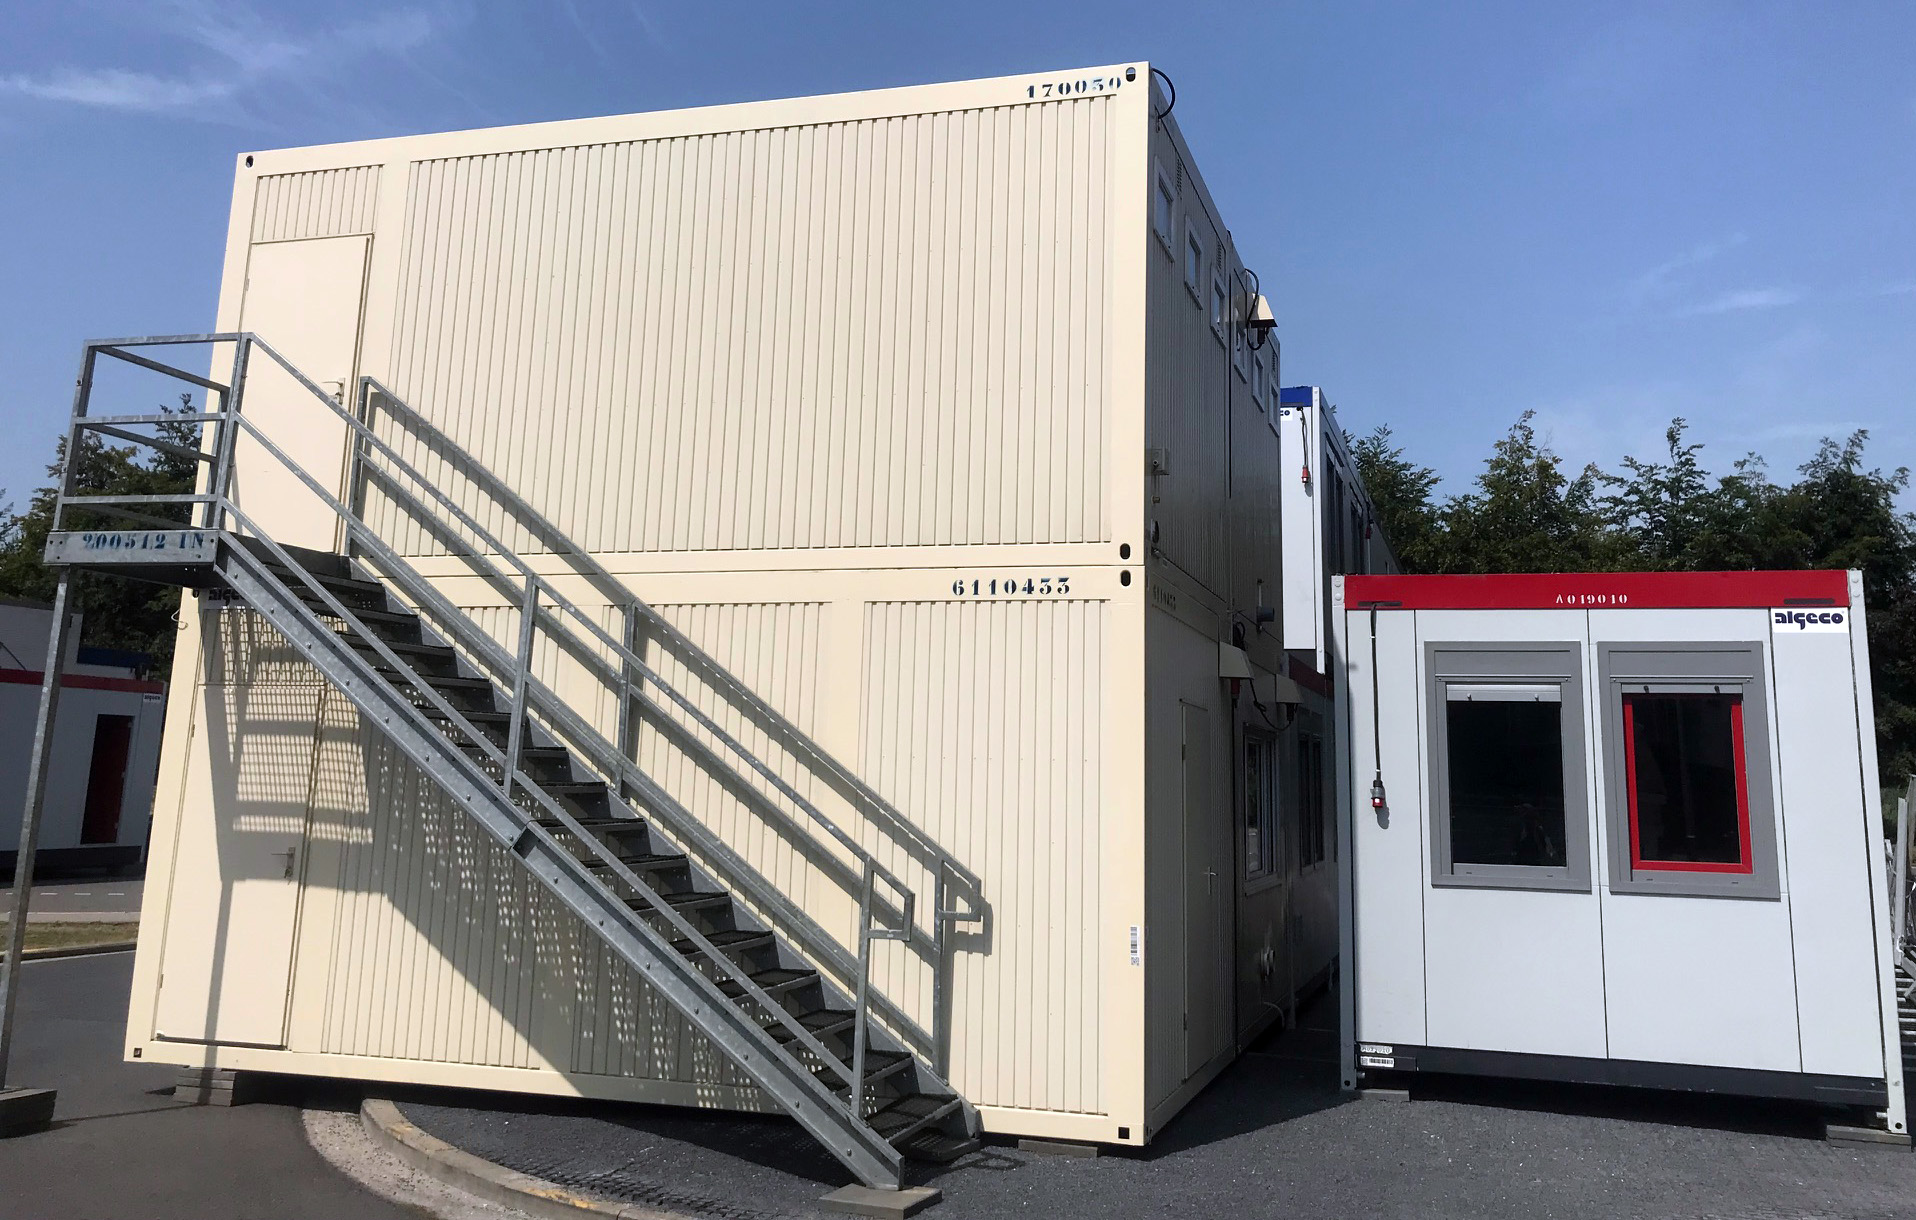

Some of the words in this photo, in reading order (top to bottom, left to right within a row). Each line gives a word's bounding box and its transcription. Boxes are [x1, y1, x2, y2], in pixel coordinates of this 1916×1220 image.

[82, 532, 166, 550] 200512
[178, 531, 205, 549] IN
[952, 577, 1070, 596] 6110433
[1555, 594, 1628, 604] A019010
[1774, 610, 1844, 631] algeco
